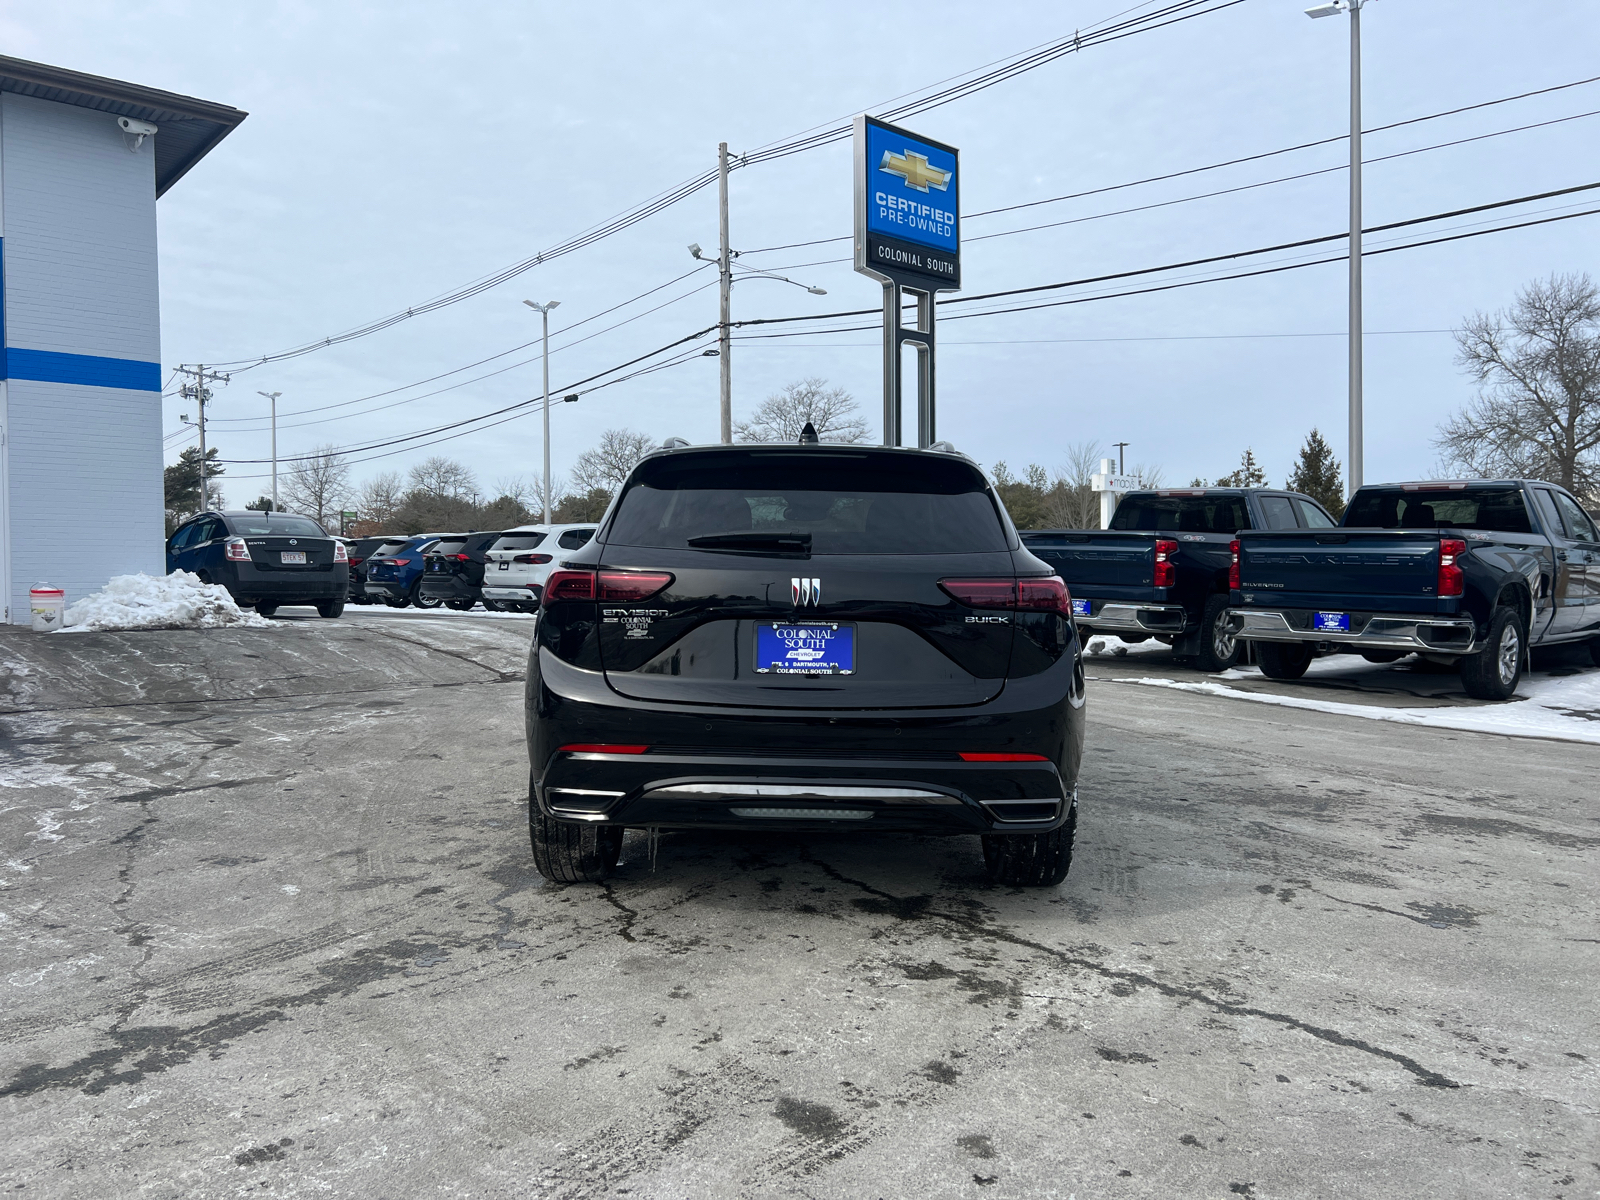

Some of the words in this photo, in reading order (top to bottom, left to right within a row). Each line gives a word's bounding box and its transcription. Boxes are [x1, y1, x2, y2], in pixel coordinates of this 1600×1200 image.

[875, 191, 955, 225] CERTIFIED
[880, 206, 951, 237] PRE-OWNED
[878, 245, 922, 267] COLONIAL
[927, 257, 954, 275] SOUTH
[602, 609, 670, 617] ENVISION
[964, 616, 1010, 624] BUICK
[776, 628, 836, 640] COLONIAL
[784, 638, 826, 649] SOUTH
